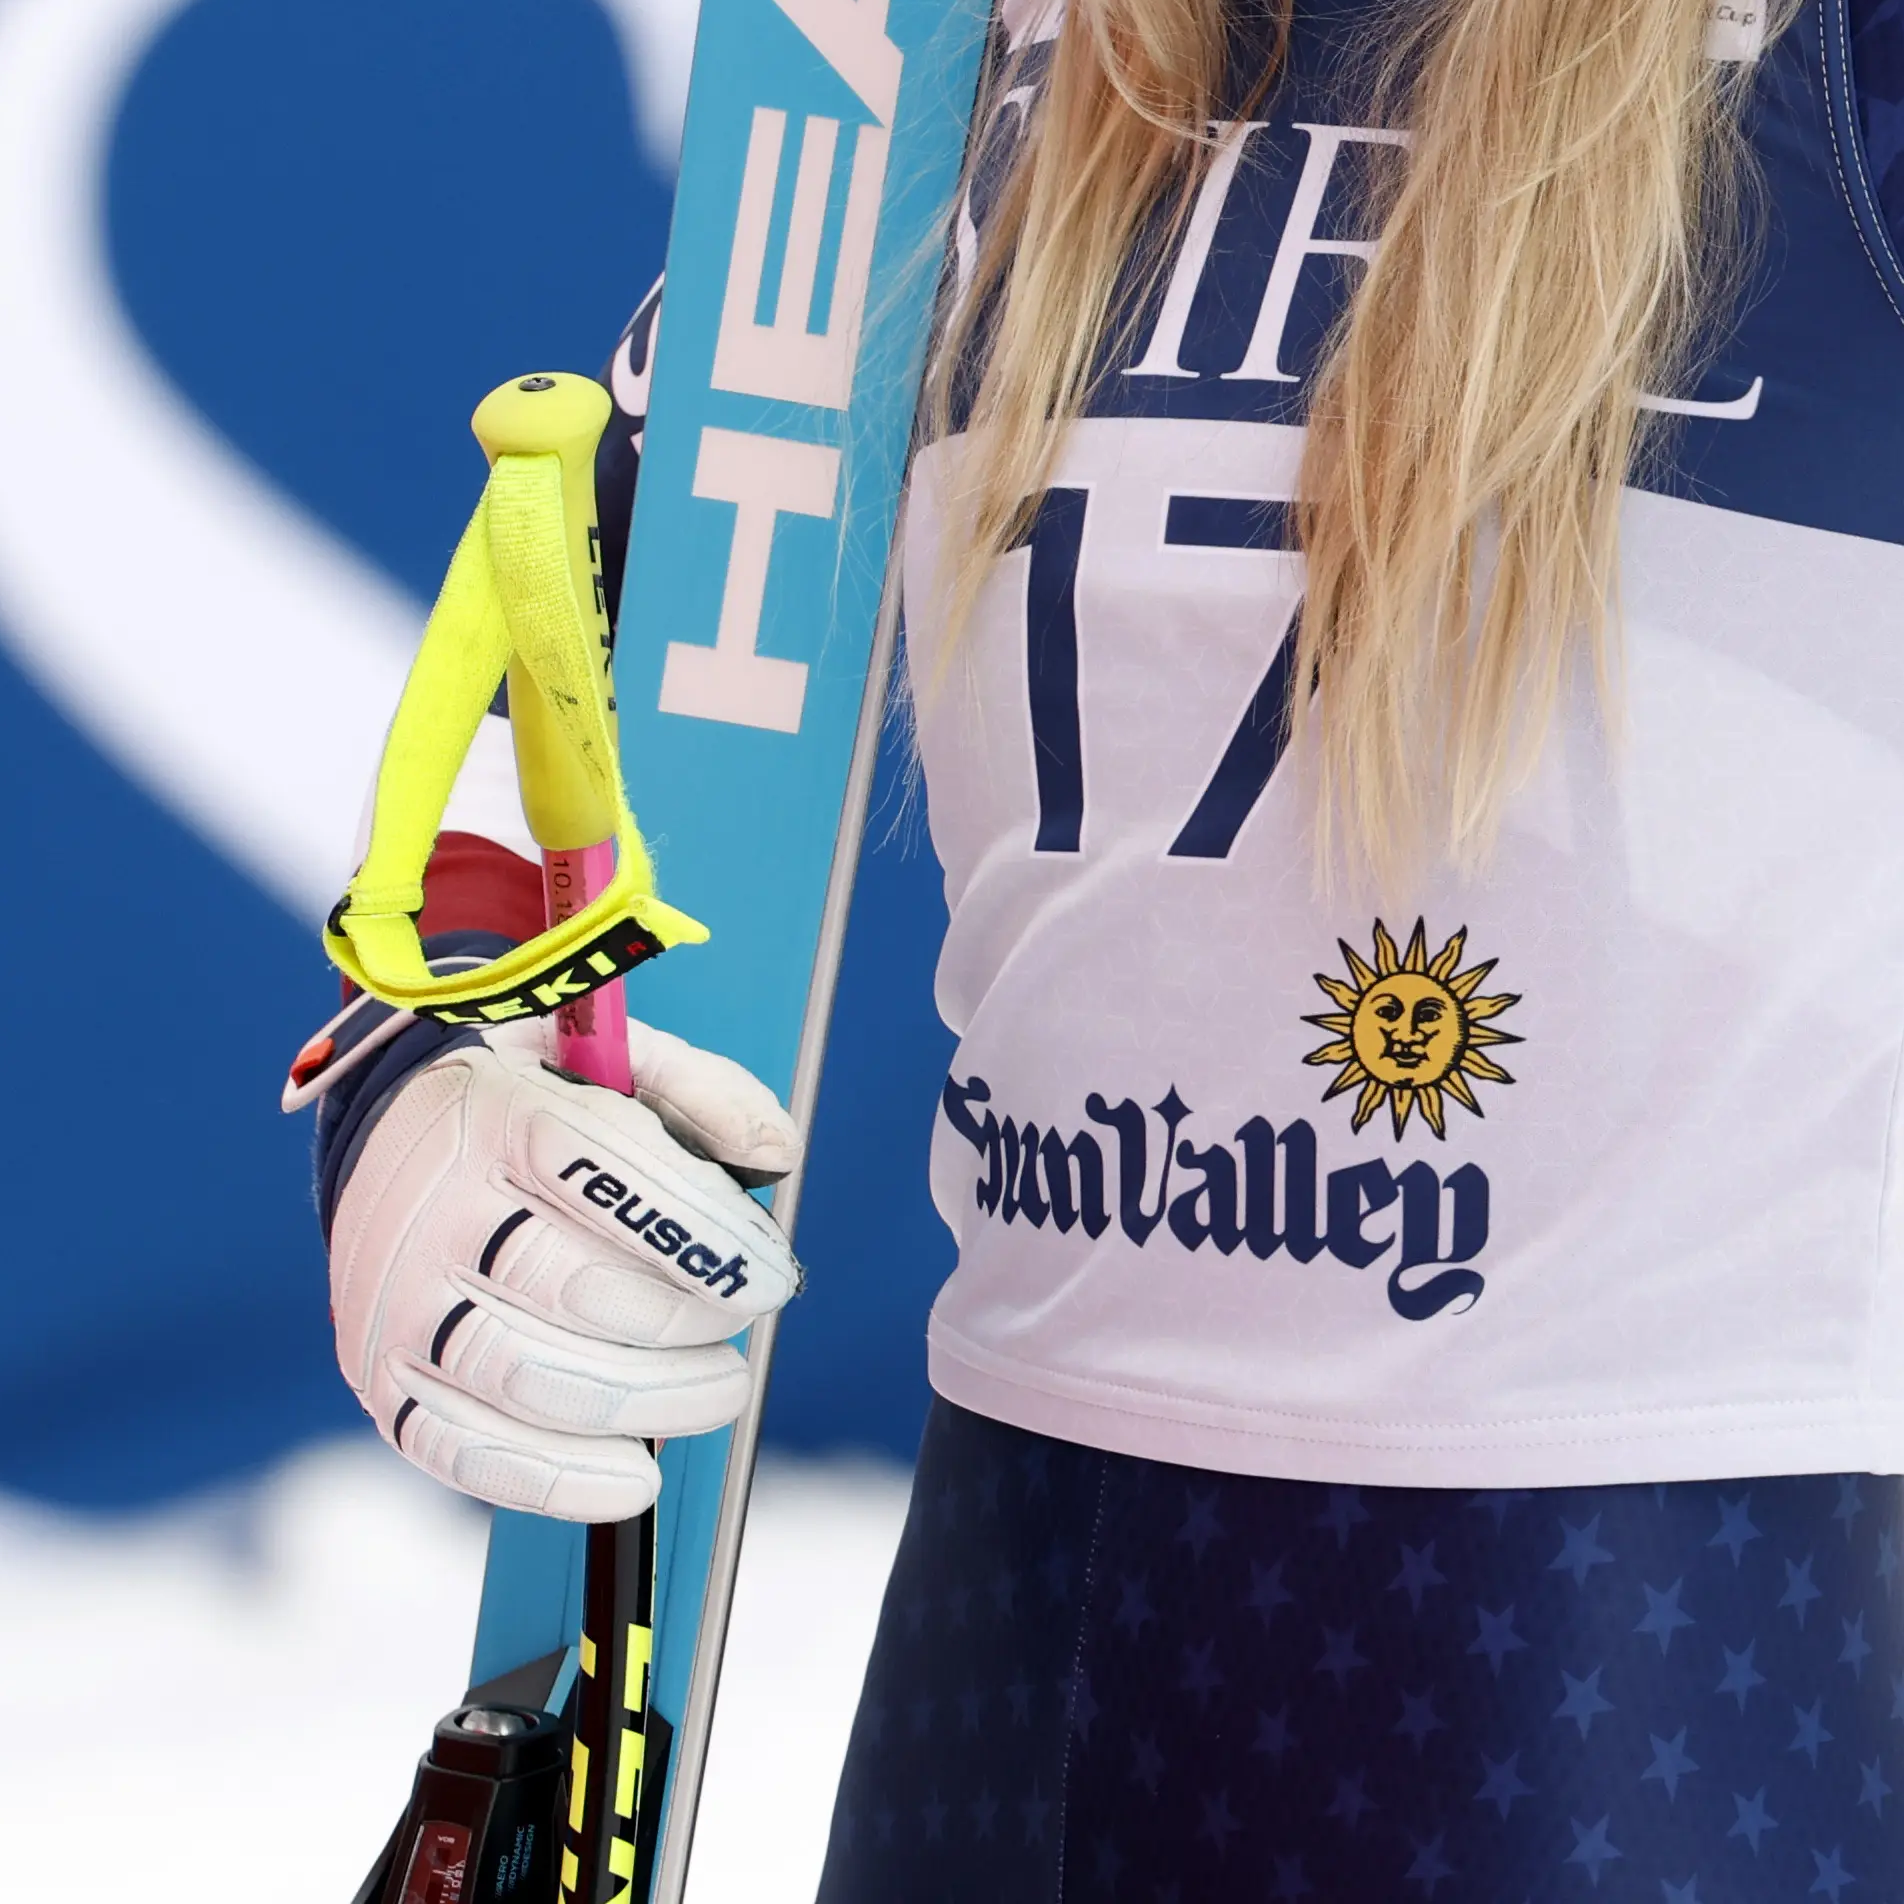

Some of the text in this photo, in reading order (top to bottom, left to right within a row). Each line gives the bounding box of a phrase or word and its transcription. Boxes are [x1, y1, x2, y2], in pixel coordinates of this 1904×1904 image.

[1001, 483, 1321, 862] 17
[432, 949, 618, 1026] LEKI
[557, 1156, 749, 1299] reusch
